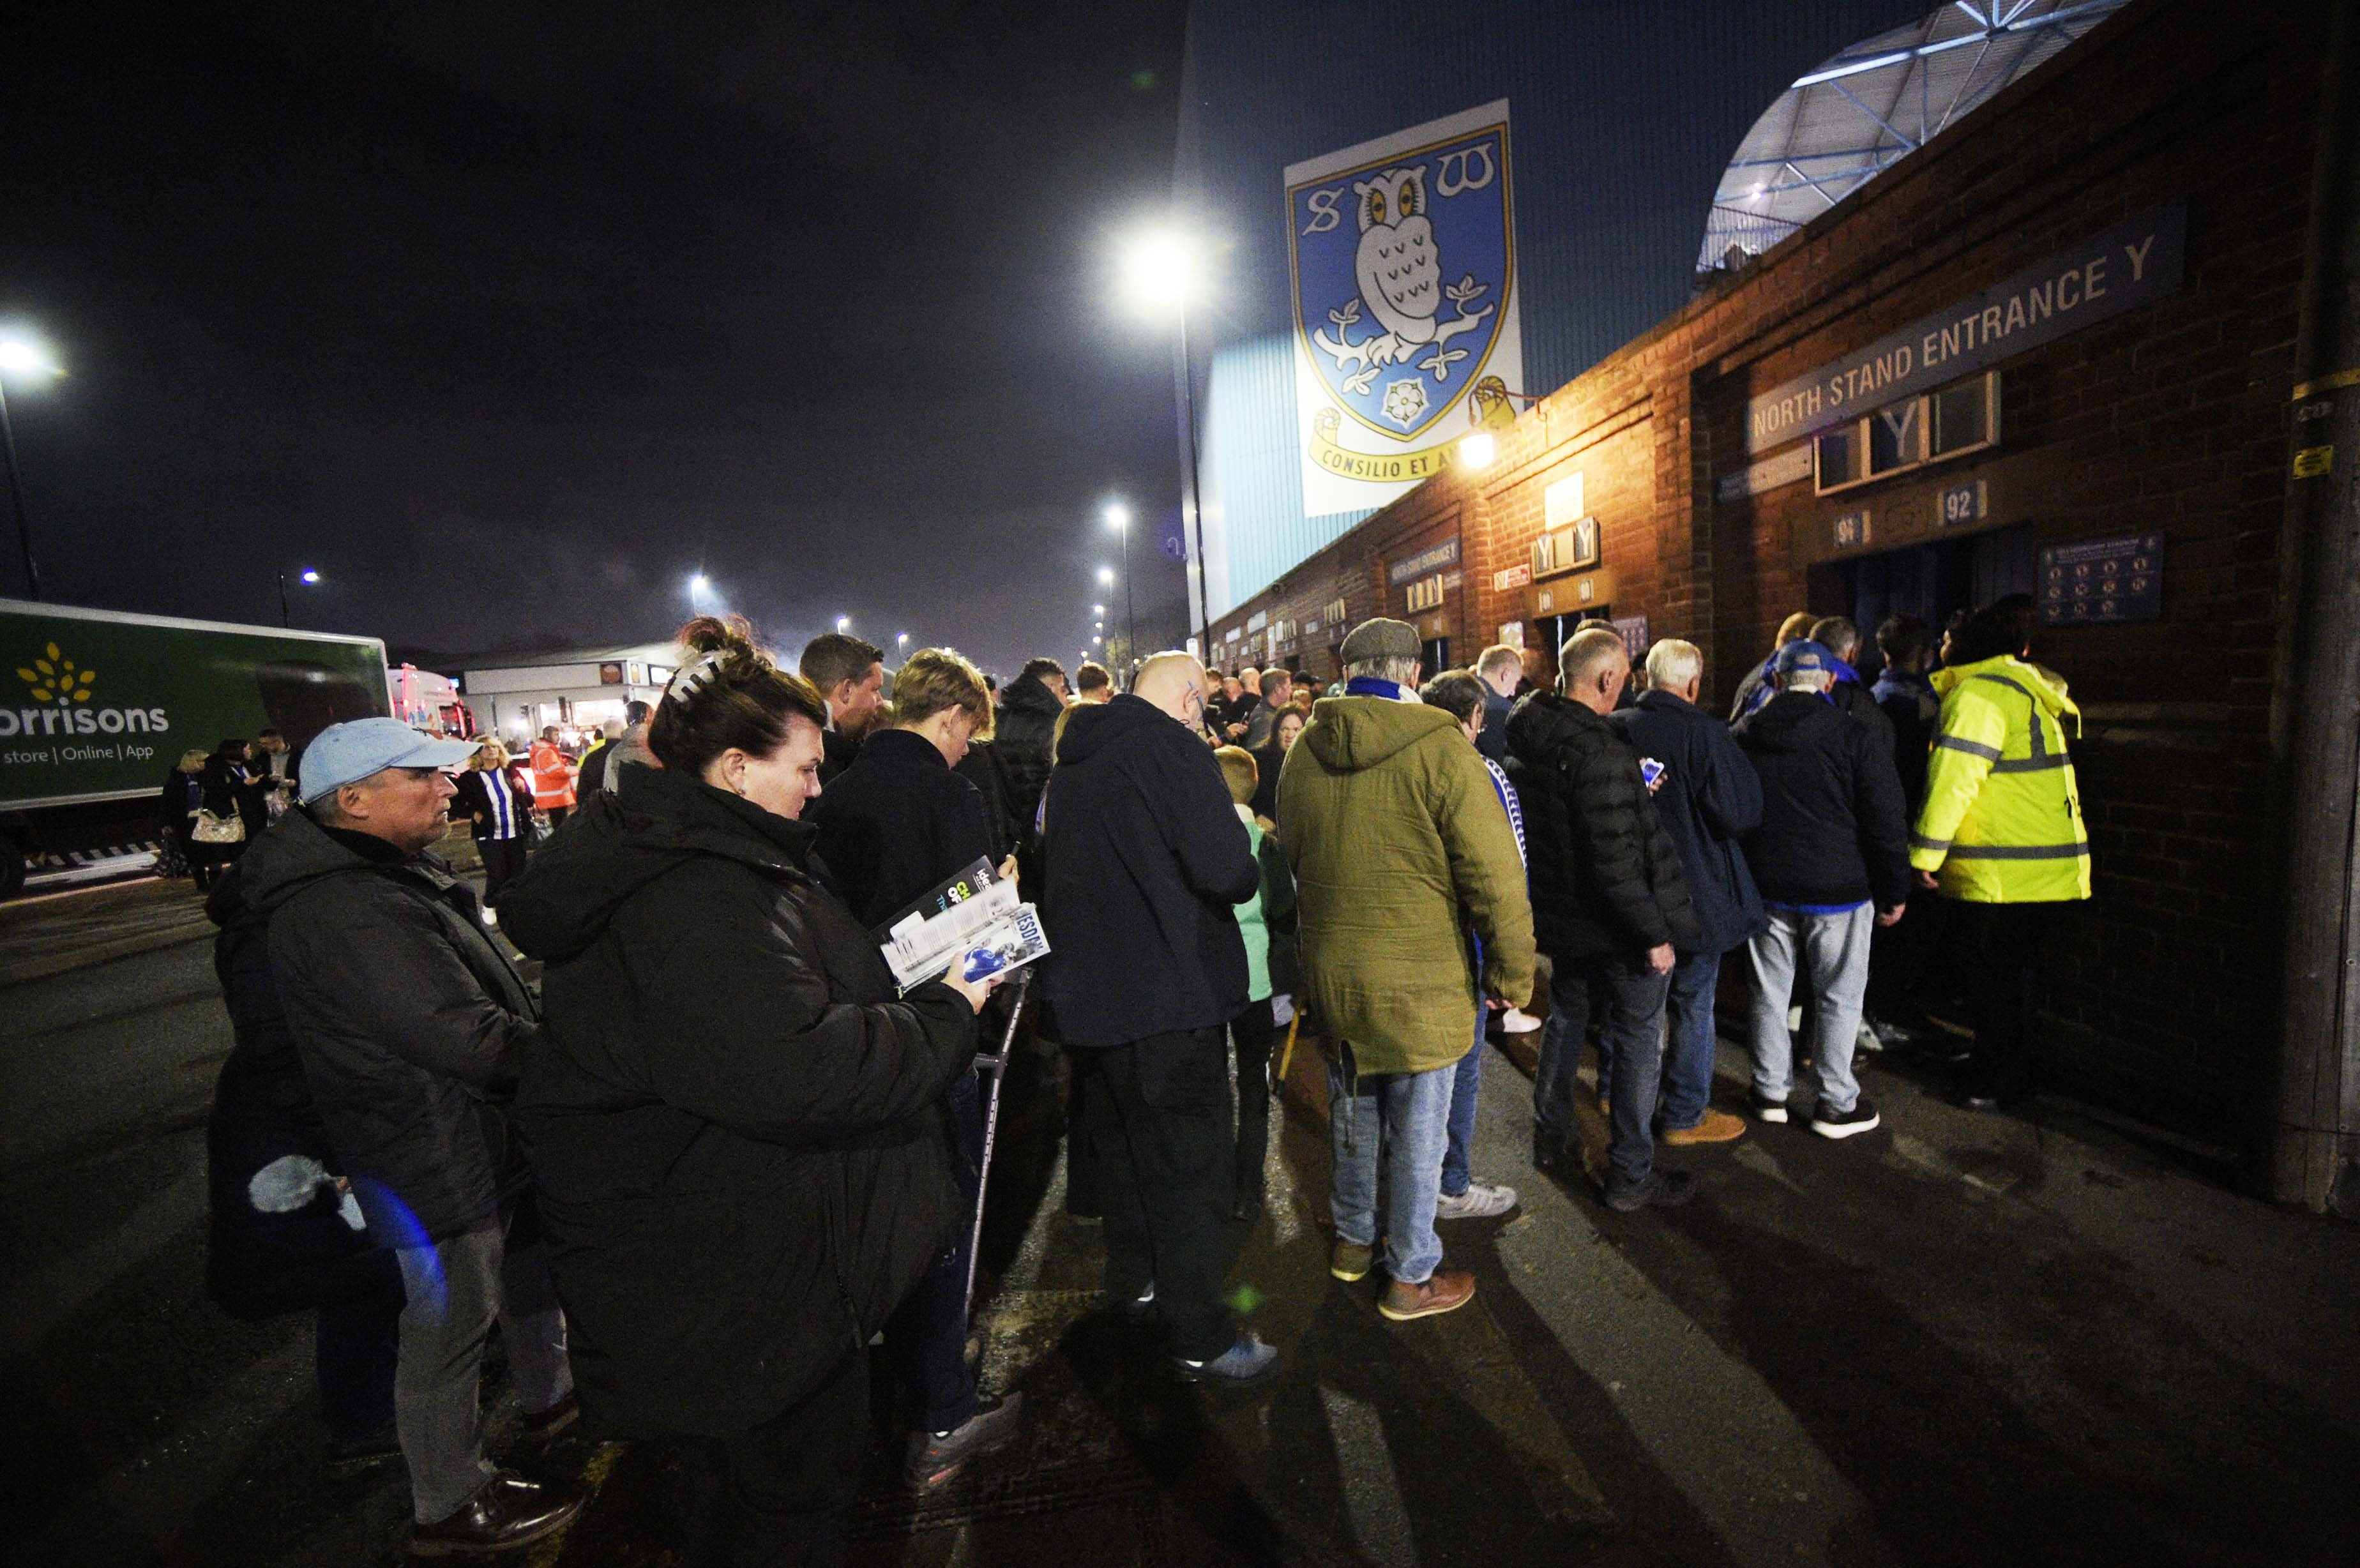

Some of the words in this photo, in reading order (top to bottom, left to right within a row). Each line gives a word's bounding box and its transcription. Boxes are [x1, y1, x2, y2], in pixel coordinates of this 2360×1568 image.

[1302, 187, 1346, 236] S
[1437, 142, 1495, 197] W
[1753, 385, 1821, 438] NORTH
[1830, 345, 1912, 406] STAND
[1922, 256, 2107, 368] ENTRANCE
[2124, 234, 2156, 282] Y
[1879, 400, 1918, 458] Y
[1322, 449, 1400, 478] CONSILIO
[1411, 456, 1428, 475] ET
[1947, 490, 1971, 522] 92
[1537, 535, 1550, 571] Y
[1577, 523, 1591, 557] Y
[4, 751, 49, 764] store
[63, 744, 114, 760] Online
[126, 744, 154, 760] App
[948, 887, 963, 903] OF
[957, 881, 971, 902] CH
